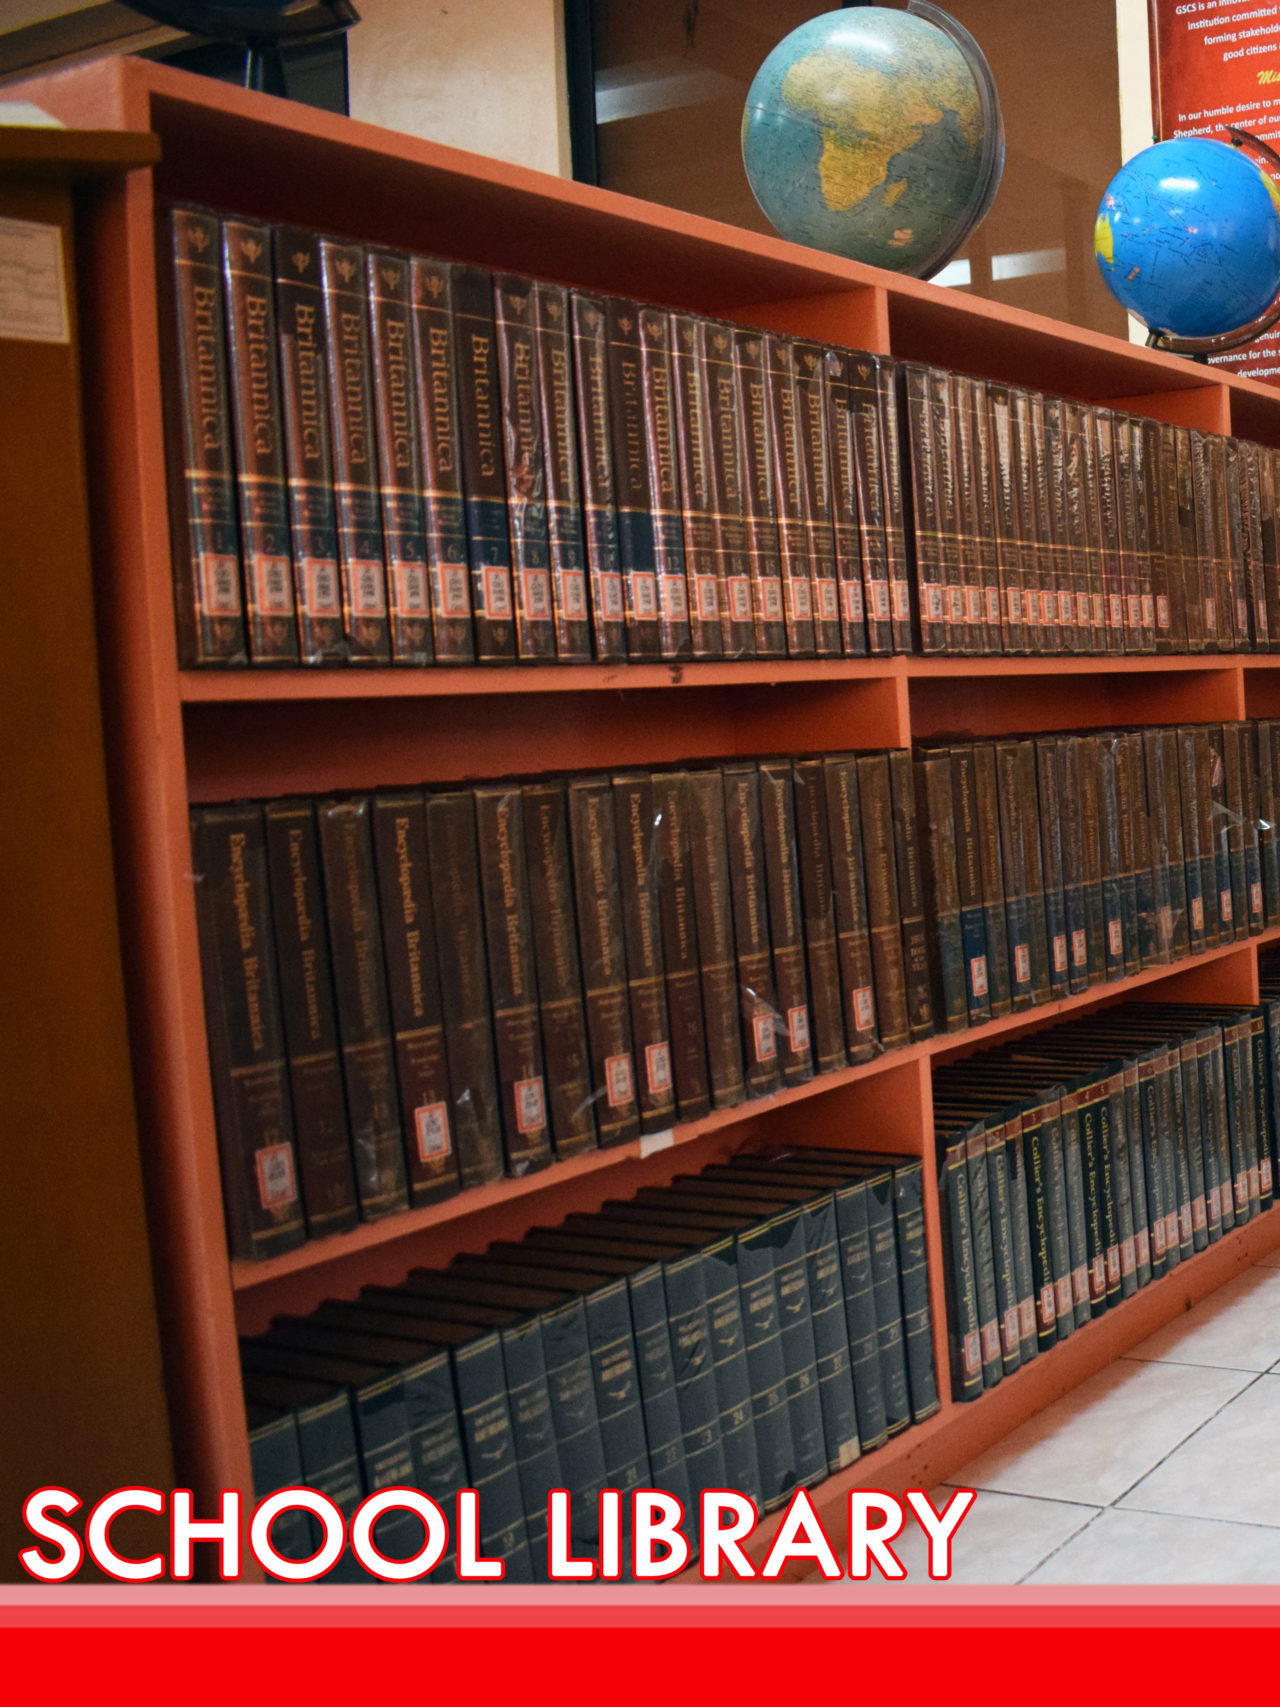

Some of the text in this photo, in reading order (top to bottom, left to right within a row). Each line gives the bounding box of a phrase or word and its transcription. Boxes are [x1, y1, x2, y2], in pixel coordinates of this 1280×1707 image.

[1176, 2, 1196, 15] GSCS
[1198, 2, 1205, 10] is
[1206, 0, 1217, 9] an
[1188, 16, 1230, 30] institution
[1232, 5, 1278, 22] committed
[1204, 31, 1238, 46] forming
[1223, 48, 1244, 62] good
[1246, 43, 1277, 56] citizens
[1173, 124, 1214, 139] Shepherd,
[1230, 118, 1256, 129] center
[1258, 115, 1267, 125] of
[1178, 114, 1186, 122] In
[1188, 111, 1202, 120] our
[1203, 105, 1234, 118] humble
[1236, 102, 1260, 112] desire
[1262, 100, 1272, 108] to
[195, 286, 220, 450] Britannica
[247, 295, 272, 455] Britannica
[296, 303, 321, 460] Britannica
[342, 312, 366, 465] Britannica
[386, 319, 412, 468] Britannica
[430, 328, 454, 473] Britannica
[472, 334, 496, 478] Britannica
[552, 350, 571, 485] Britannica
[1208, 353, 1248, 365] overnance
[1248, 350, 1261, 360] for
[1262, 348, 1276, 359] the
[653, 366, 674, 494] Britannica
[718, 378, 737, 499] Britannica
[1031, 1136, 1050, 1285] Collier's Encyclopedi
[1084, 1112, 1102, 1252] Collier's Encyclopedi
[1100, 1106, 1117, 1245] Collier's Encyclopedi
